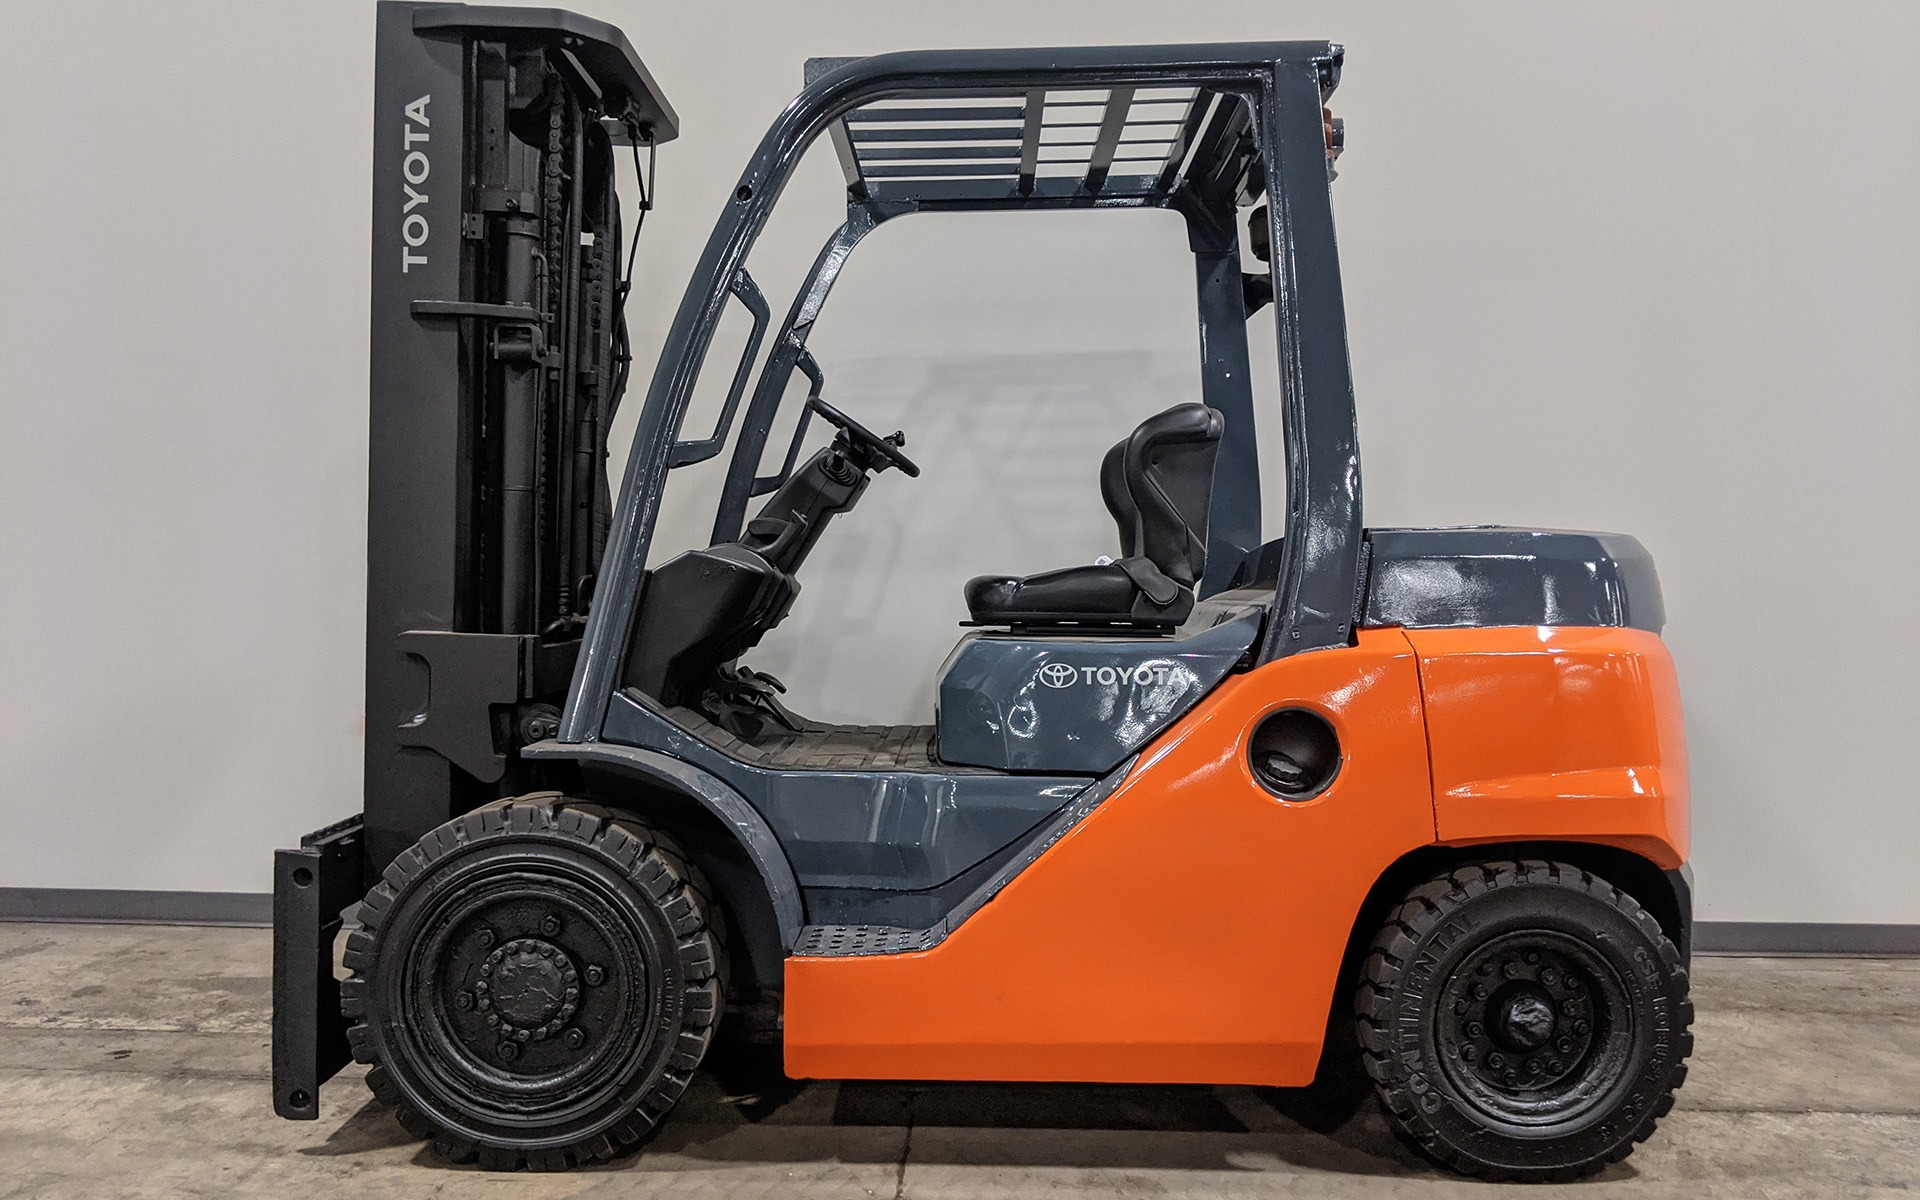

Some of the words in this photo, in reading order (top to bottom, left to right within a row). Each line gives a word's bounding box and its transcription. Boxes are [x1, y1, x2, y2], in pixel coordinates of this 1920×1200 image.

[402, 94, 431, 273] TOYOTA
[1081, 666, 1188, 686] TOYOTA
[1398, 912, 1481, 1115] CONTINENTAL
